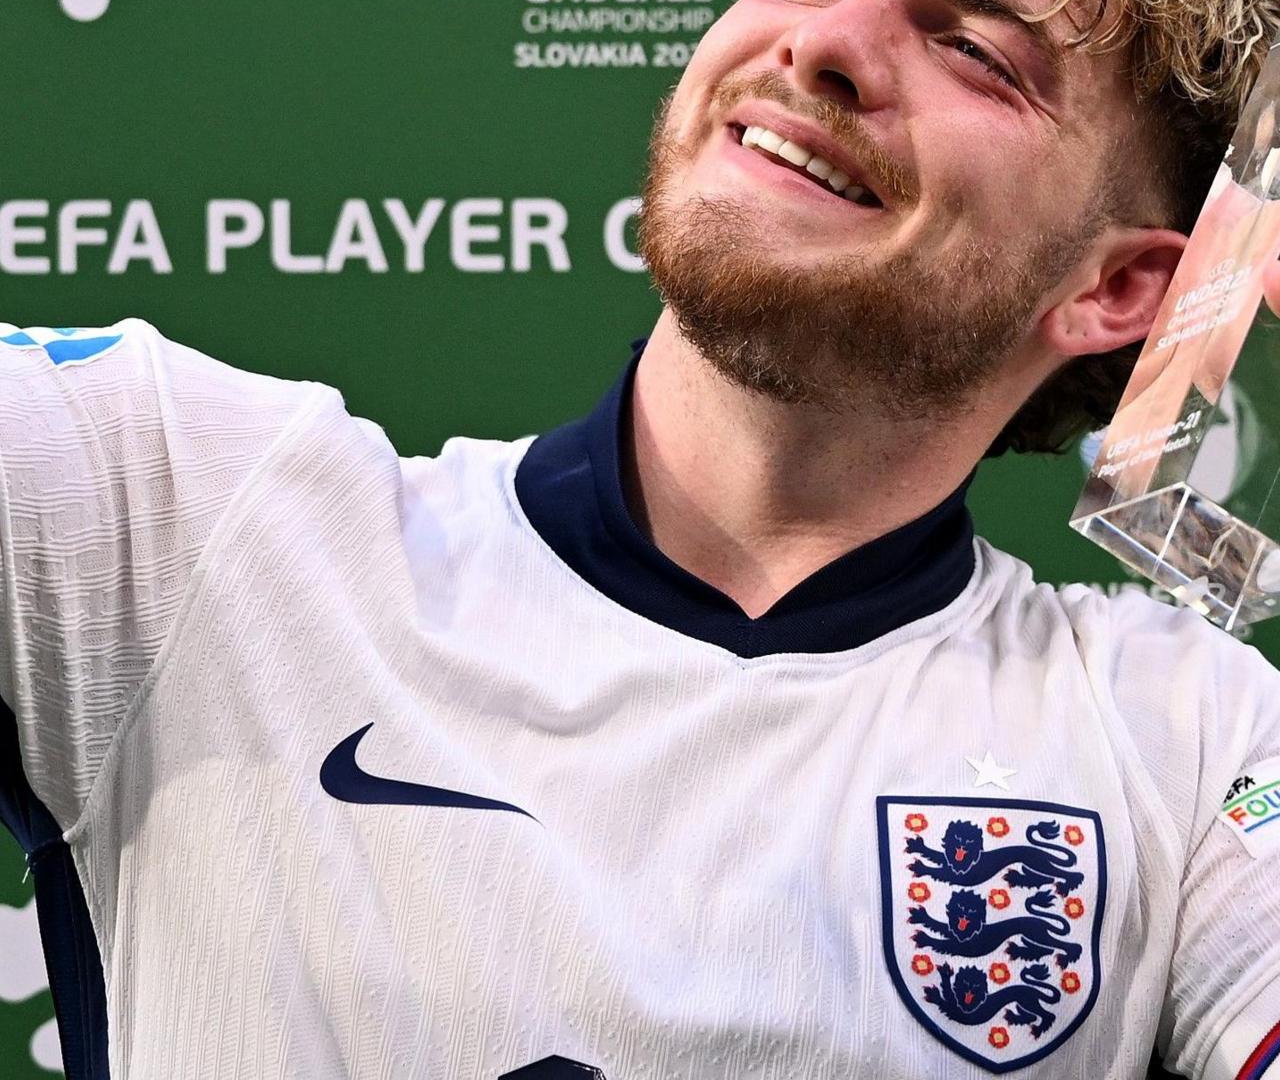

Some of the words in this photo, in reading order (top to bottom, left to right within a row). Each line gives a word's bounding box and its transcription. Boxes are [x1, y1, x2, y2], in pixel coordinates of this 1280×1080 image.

[523, 7, 715, 33] CHAMPIONSHIP
[514, 41, 647, 67] SLOVAKIA
[653, 43, 695, 67] 20
[207, 198, 570, 273] PLAYER
